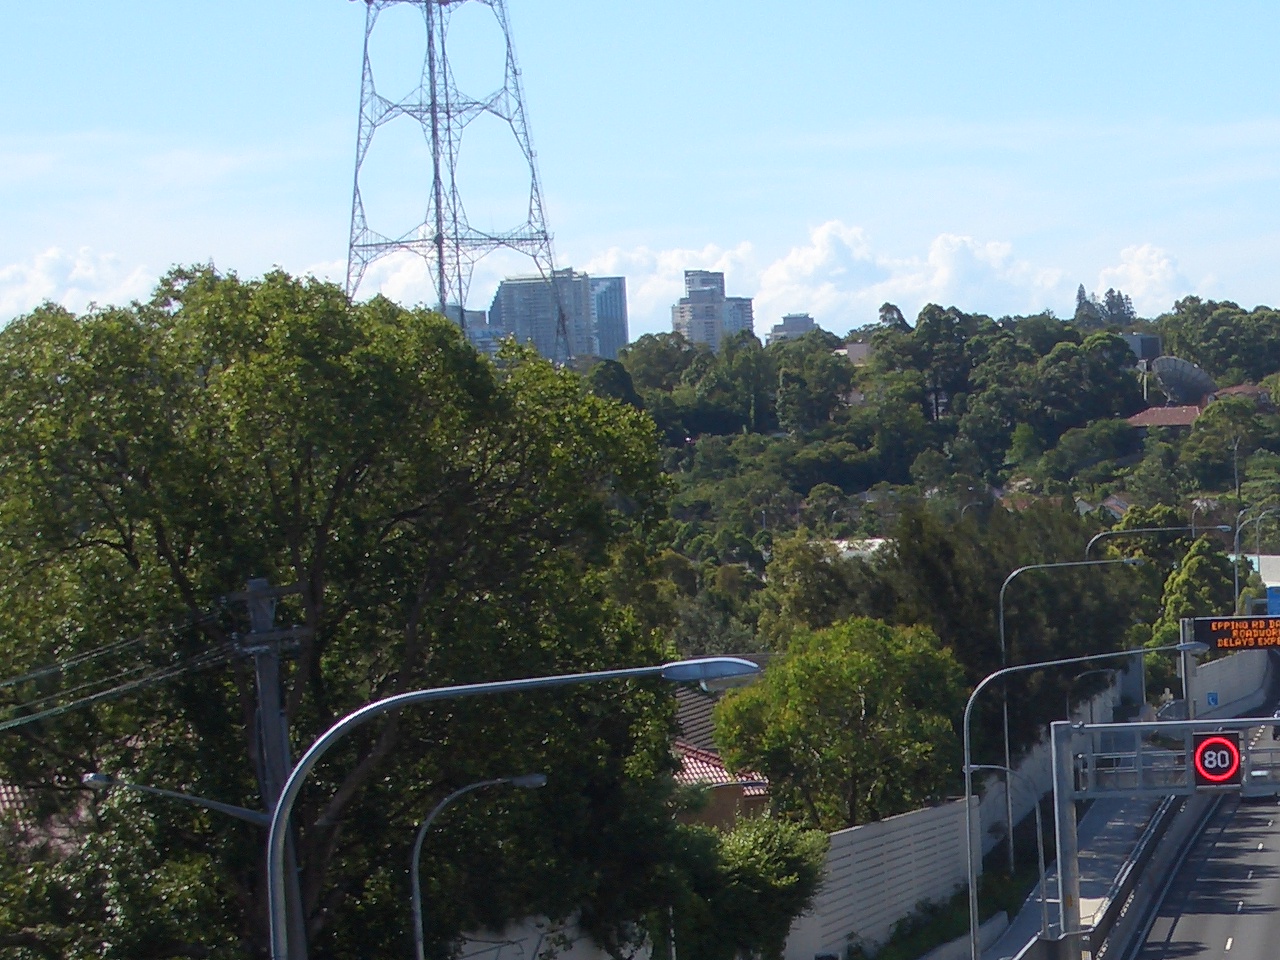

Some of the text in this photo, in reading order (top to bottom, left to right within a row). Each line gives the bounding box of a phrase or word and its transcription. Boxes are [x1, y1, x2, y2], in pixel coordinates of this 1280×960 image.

[1211, 620, 1249, 631] EPPING
[1251, 619, 1265, 629] RD
[1217, 637, 1255, 648] DELAYS
[1203, 750, 1230, 769] 80
